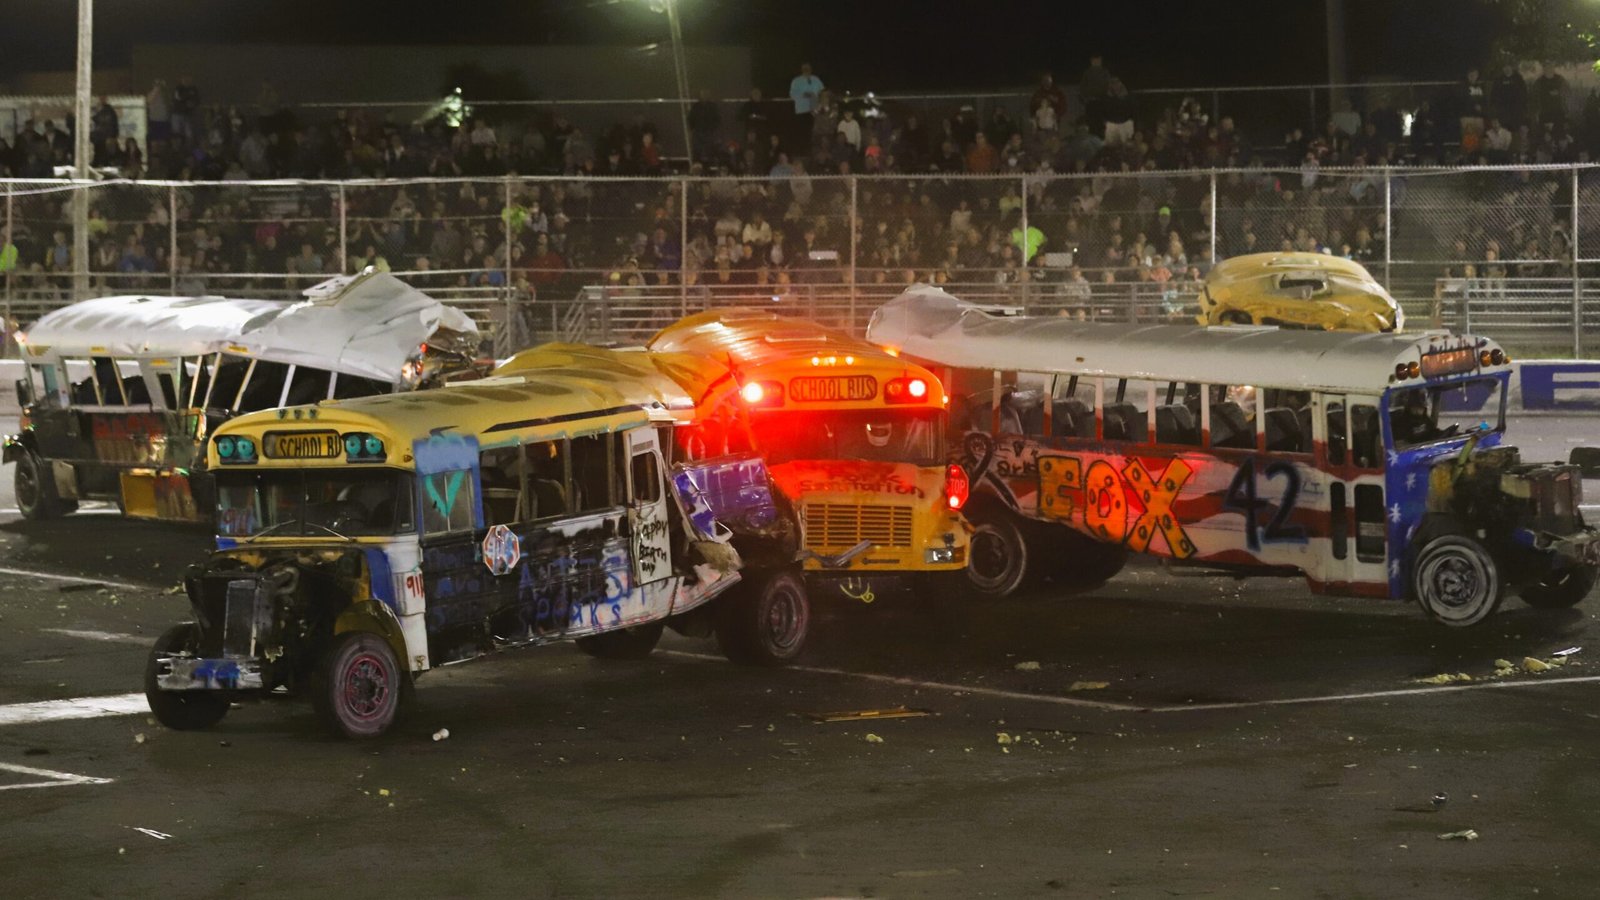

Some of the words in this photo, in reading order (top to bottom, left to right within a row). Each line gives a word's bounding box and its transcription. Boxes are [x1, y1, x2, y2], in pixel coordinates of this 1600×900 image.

[791, 379, 845, 400] SCHOOL
[848, 377, 877, 400] BUS
[279, 436, 321, 457] SCHOOL
[1036, 455, 1198, 560] FOX
[1224, 457, 1309, 552] 42
